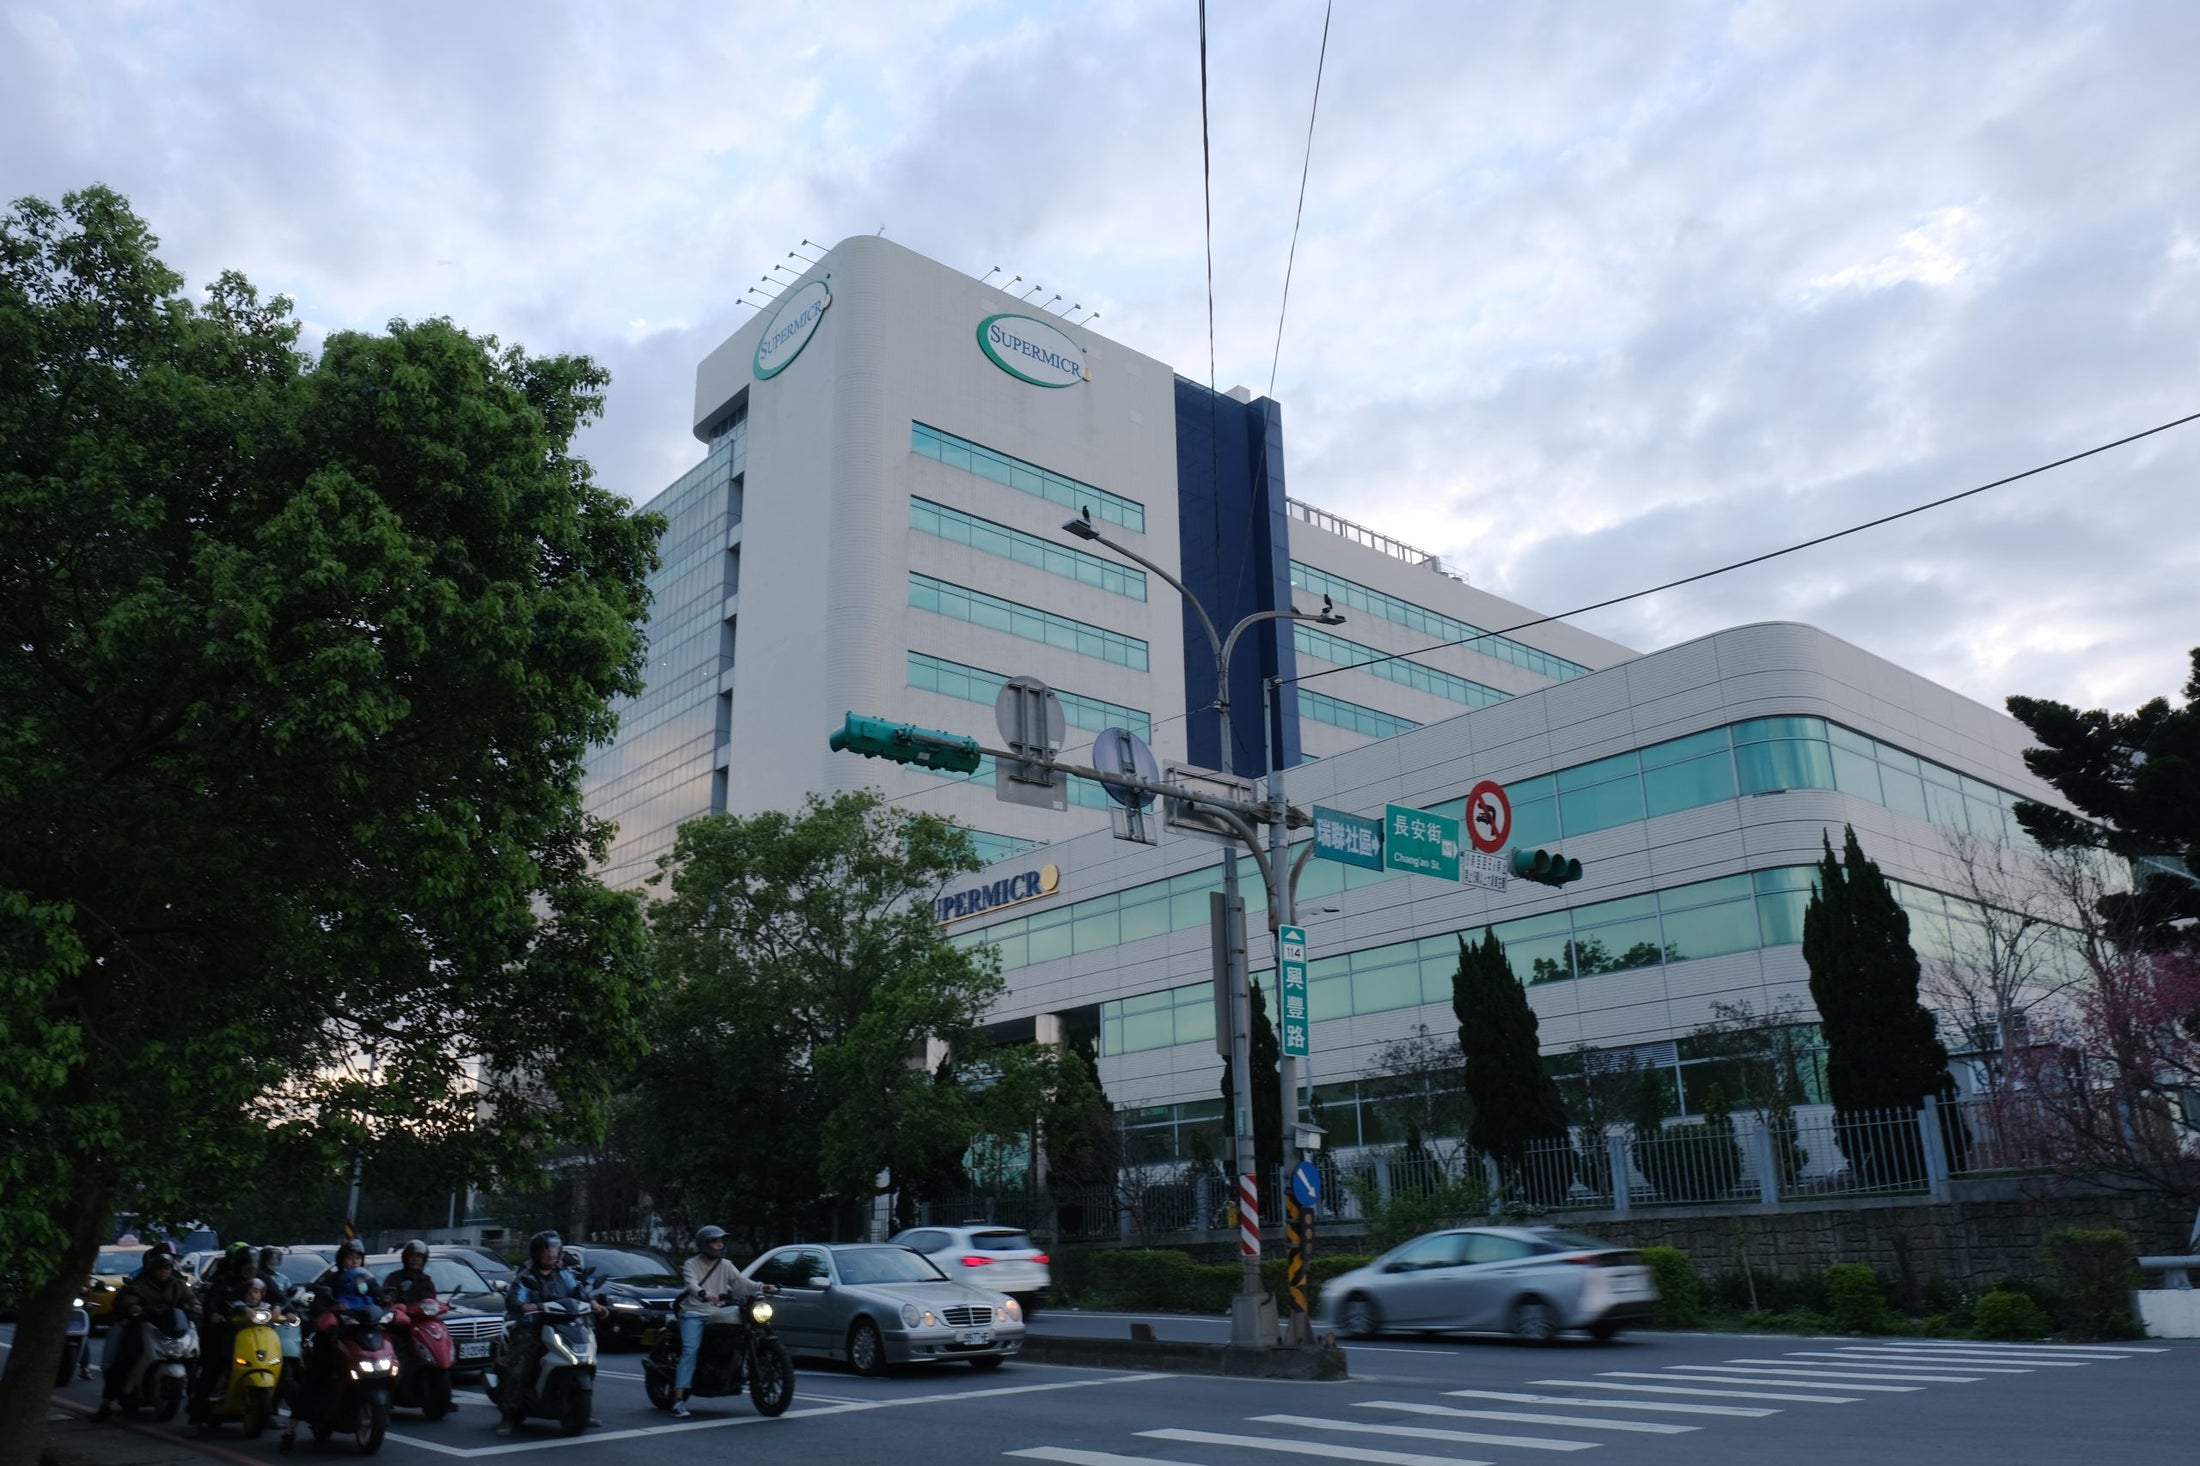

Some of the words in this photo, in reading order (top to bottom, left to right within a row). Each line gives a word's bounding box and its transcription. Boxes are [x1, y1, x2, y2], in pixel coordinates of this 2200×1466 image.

[1393, 814, 1442, 845] 長安街
[1393, 852, 1430, 868] Chang'an
[1286, 946, 1301, 958] 114
[1286, 966, 1306, 1049] 興豐路
